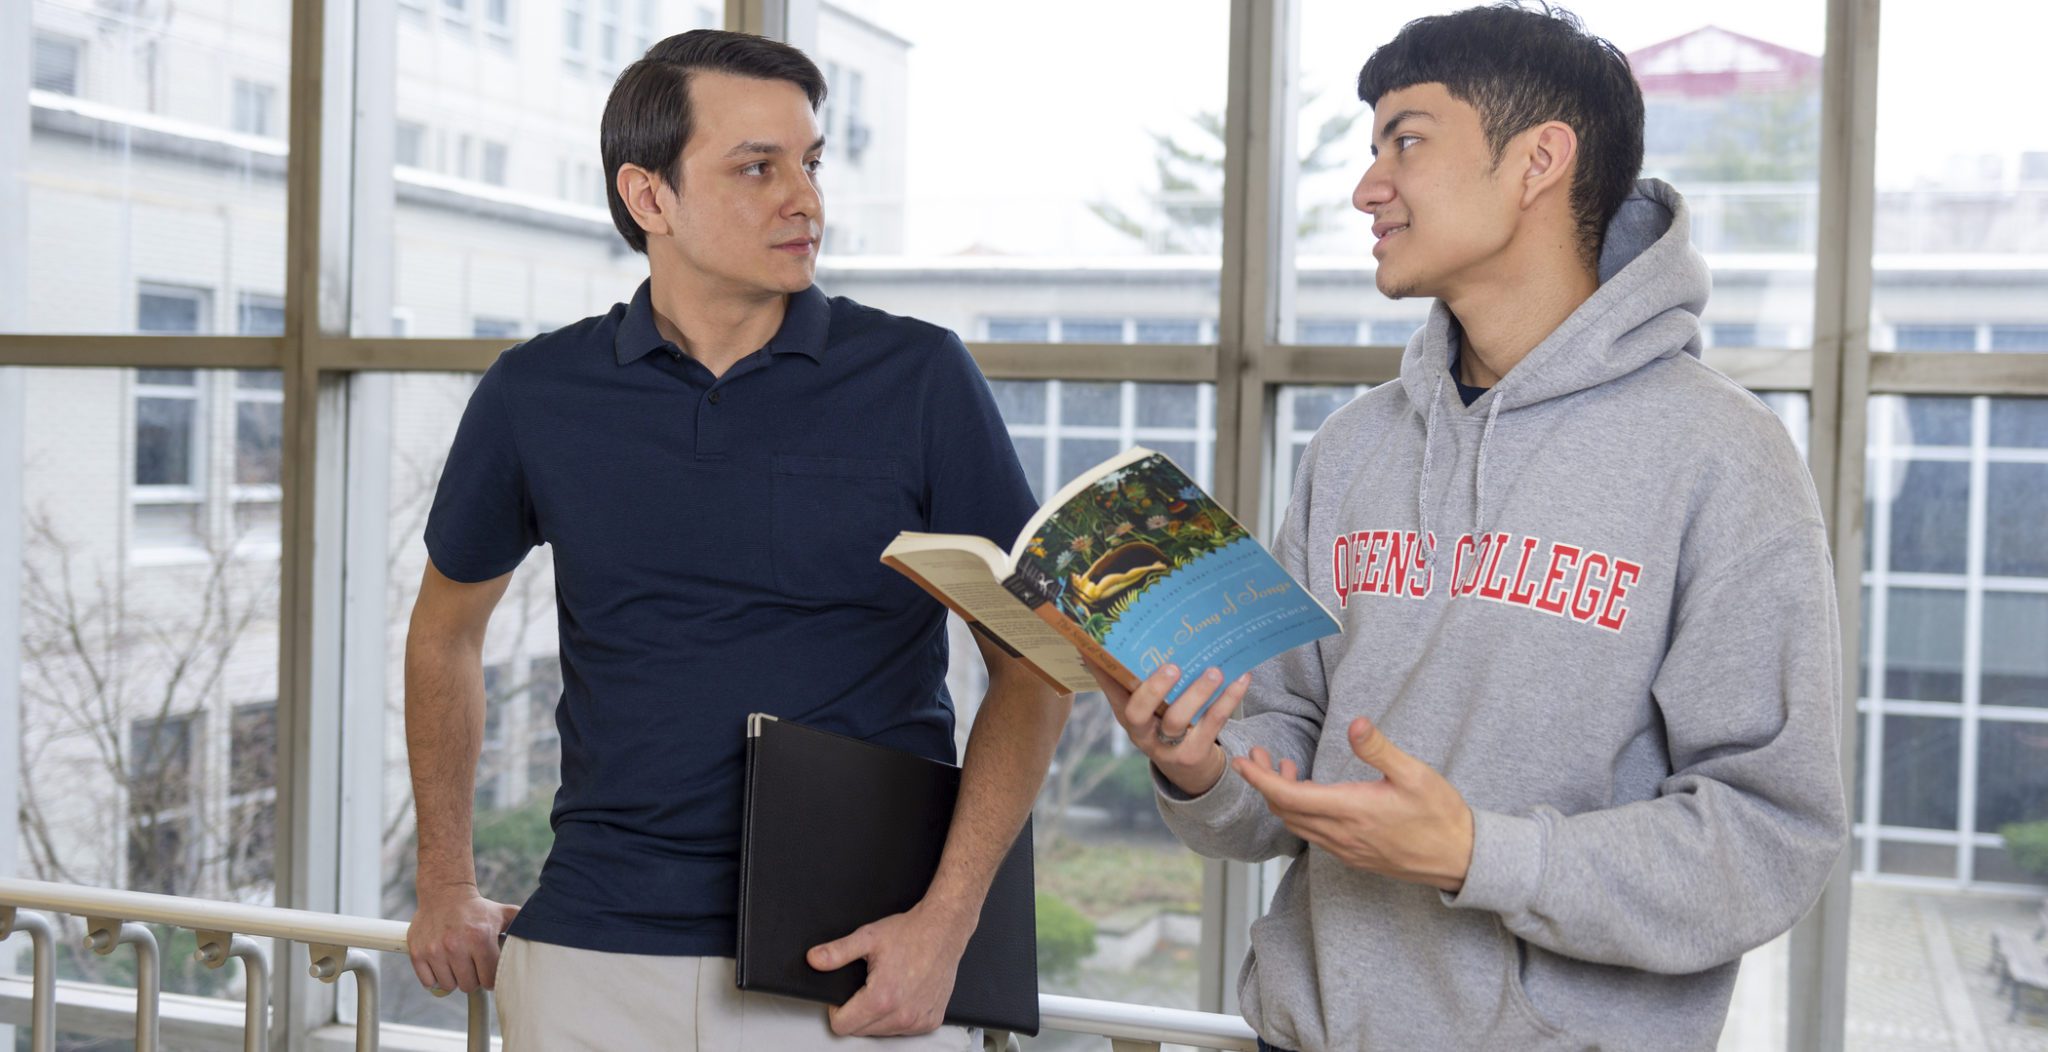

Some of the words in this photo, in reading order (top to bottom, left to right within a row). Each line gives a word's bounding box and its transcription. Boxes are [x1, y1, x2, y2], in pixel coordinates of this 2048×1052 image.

[1139, 645, 1176, 676] The
[1174, 612, 1221, 646] Song
[1222, 591, 1239, 616] of
[1237, 578, 1292, 606] Songs
[1333, 529, 1437, 609] QEENS
[1449, 531, 1643, 633] COLLEGE
[1202, 637, 1234, 662] BLOCH
[1246, 617, 1274, 634] ARIEL
[1276, 604, 1310, 620] BLOCH
